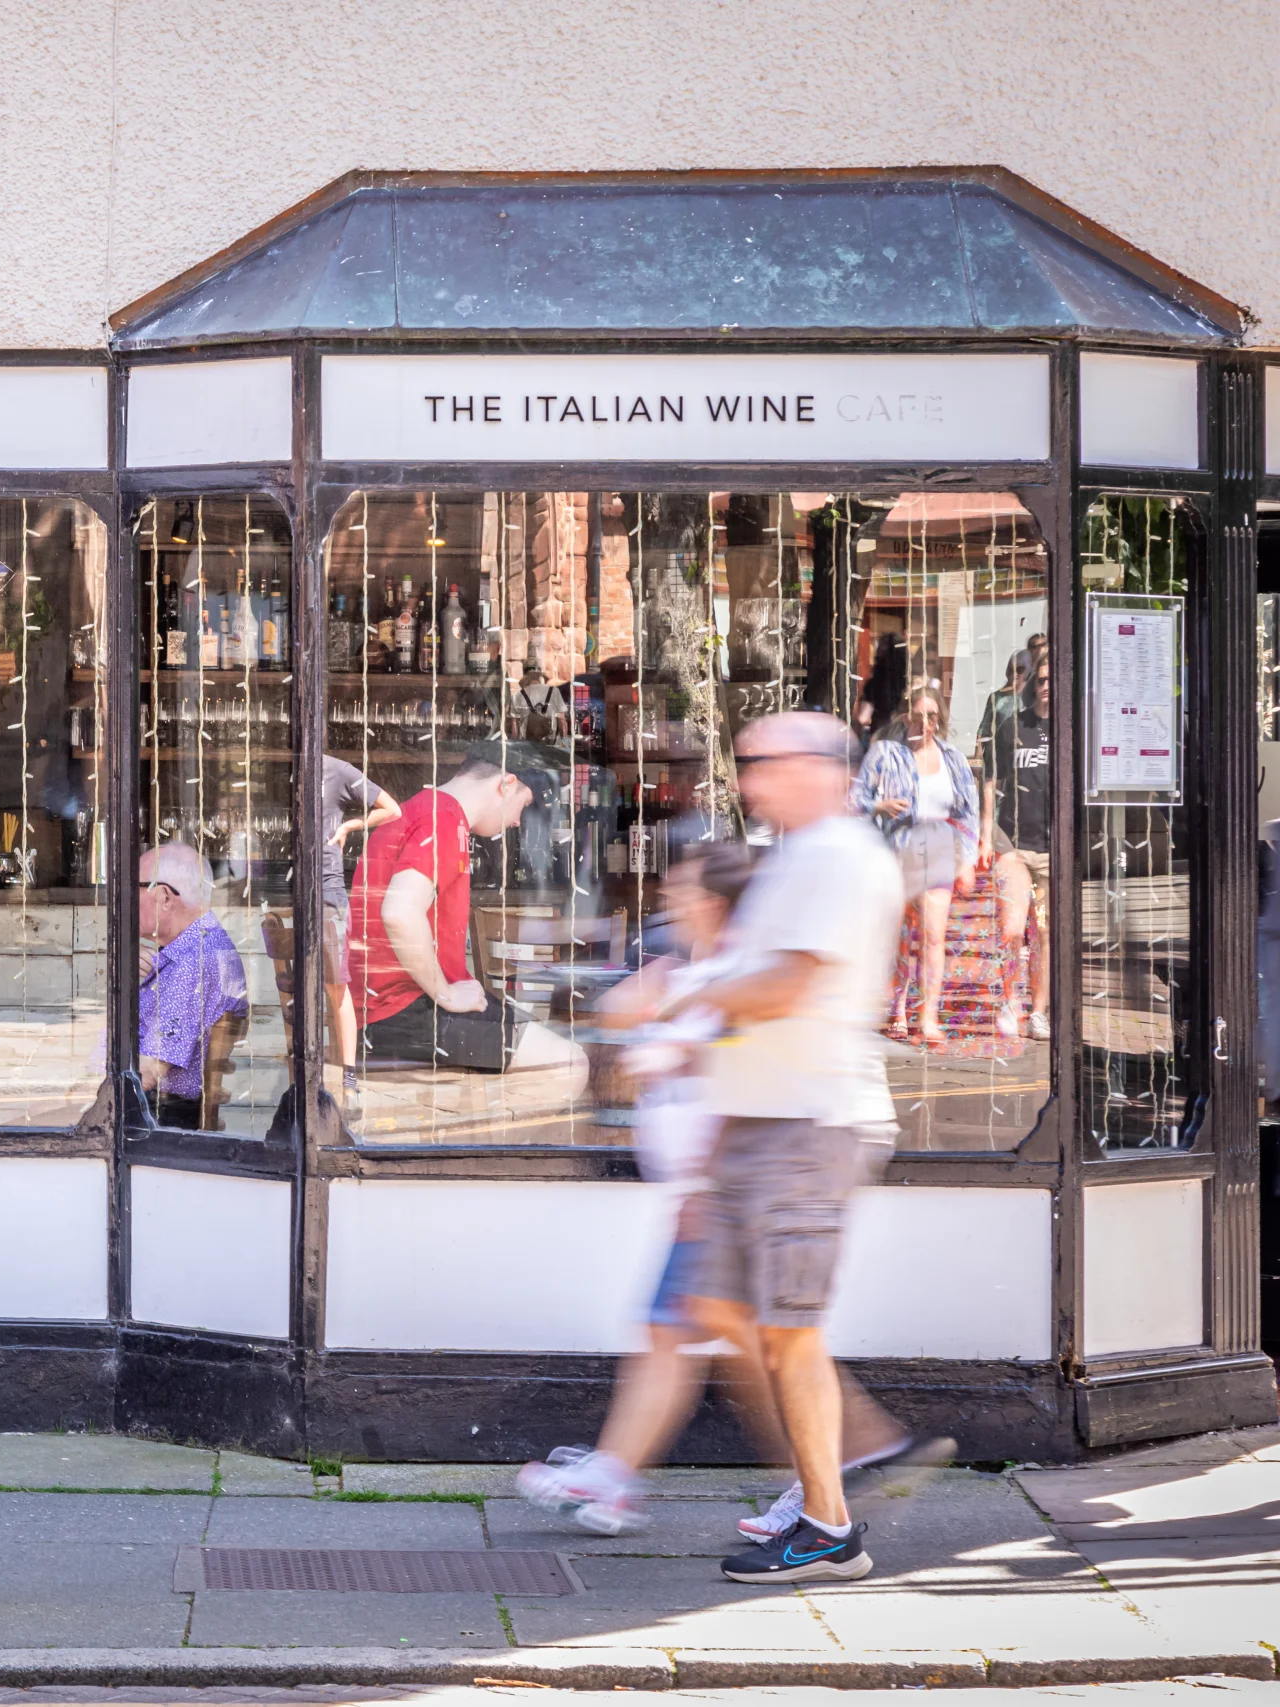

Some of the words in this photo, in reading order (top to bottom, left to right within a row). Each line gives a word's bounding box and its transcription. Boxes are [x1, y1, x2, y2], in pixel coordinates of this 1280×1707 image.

[424, 396, 502, 422] THE
[524, 396, 684, 422] ITALIAN
[706, 396, 815, 422] WINE
